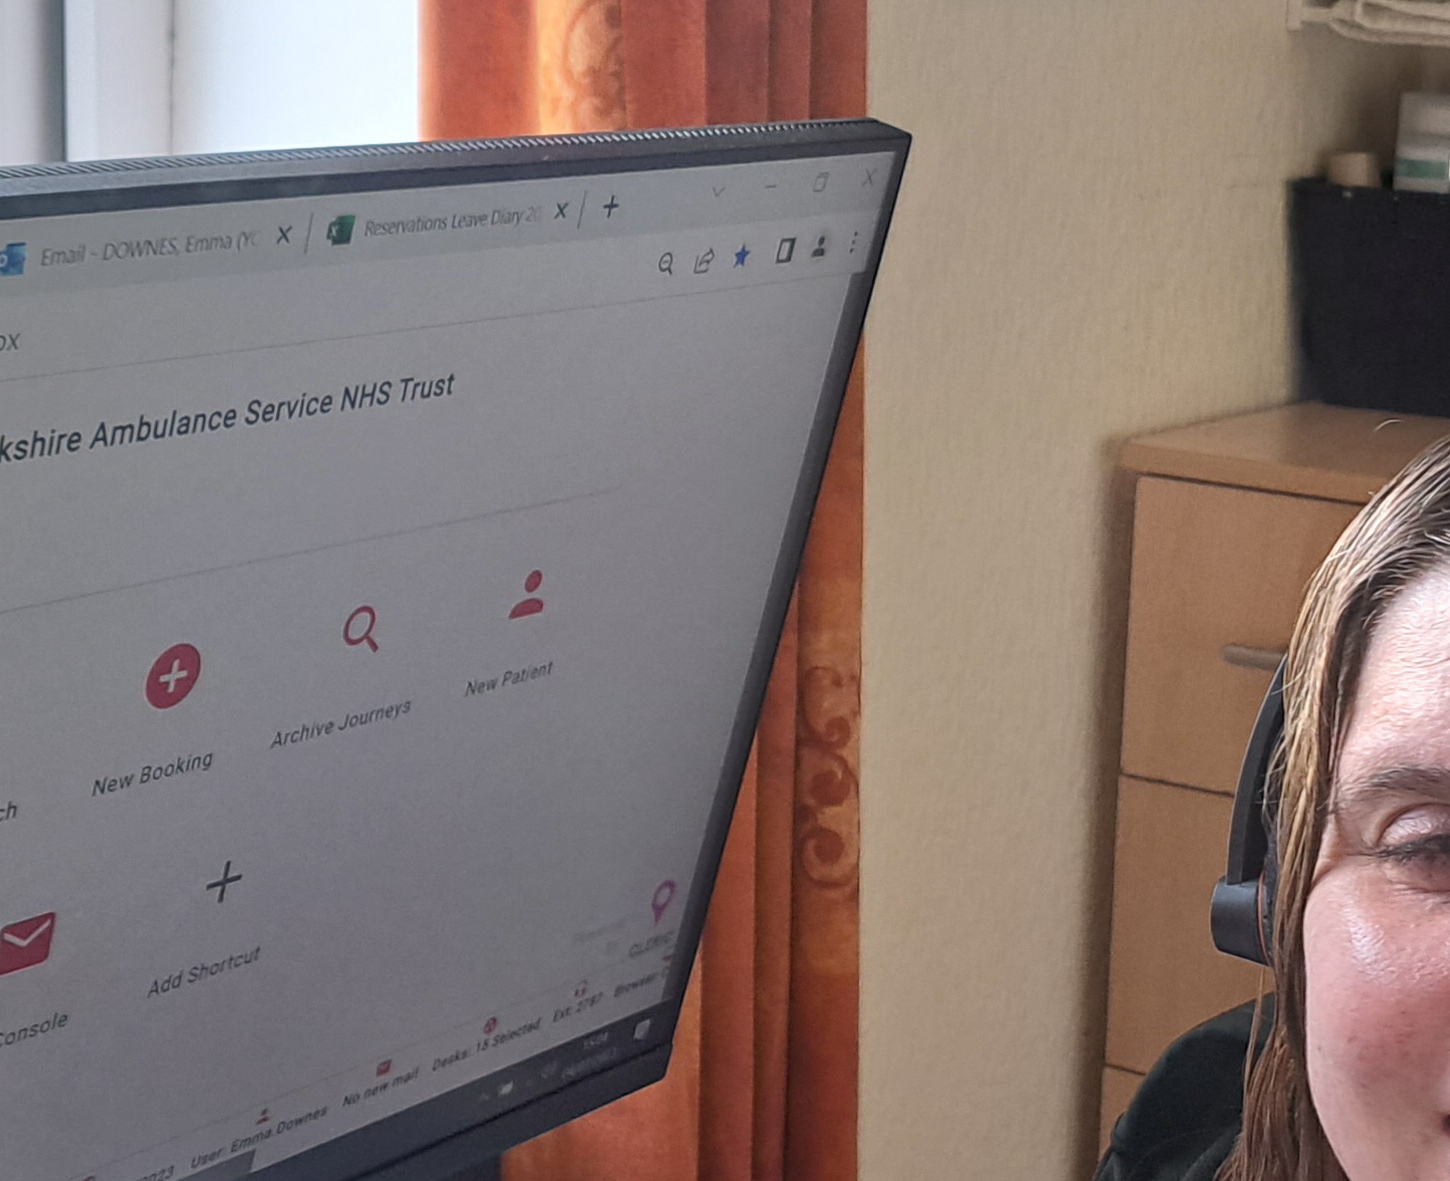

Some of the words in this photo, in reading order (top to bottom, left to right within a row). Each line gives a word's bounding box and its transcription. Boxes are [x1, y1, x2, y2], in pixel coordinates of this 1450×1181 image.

[364, 214, 447, 238] Reservations
[452, 210, 488, 230] Leave
[491, 207, 526, 230] Diary
[40, 248, 85, 267] Email
[185, 233, 234, 254] Emma
[89, 407, 236, 448] Ambulance
[244, 392, 333, 425] Service
[340, 380, 393, 411] NHS
[399, 373, 455, 402] Trust
[463, 679, 498, 697] New
[502, 660, 552, 688] Patient
[270, 717, 335, 750] Archive
[338, 699, 412, 733] Journeys
[91, 773, 134, 798] New
[139, 751, 214, 787] Booking
[147, 974, 183, 999] Add
[187, 946, 261, 984] Shortcut
